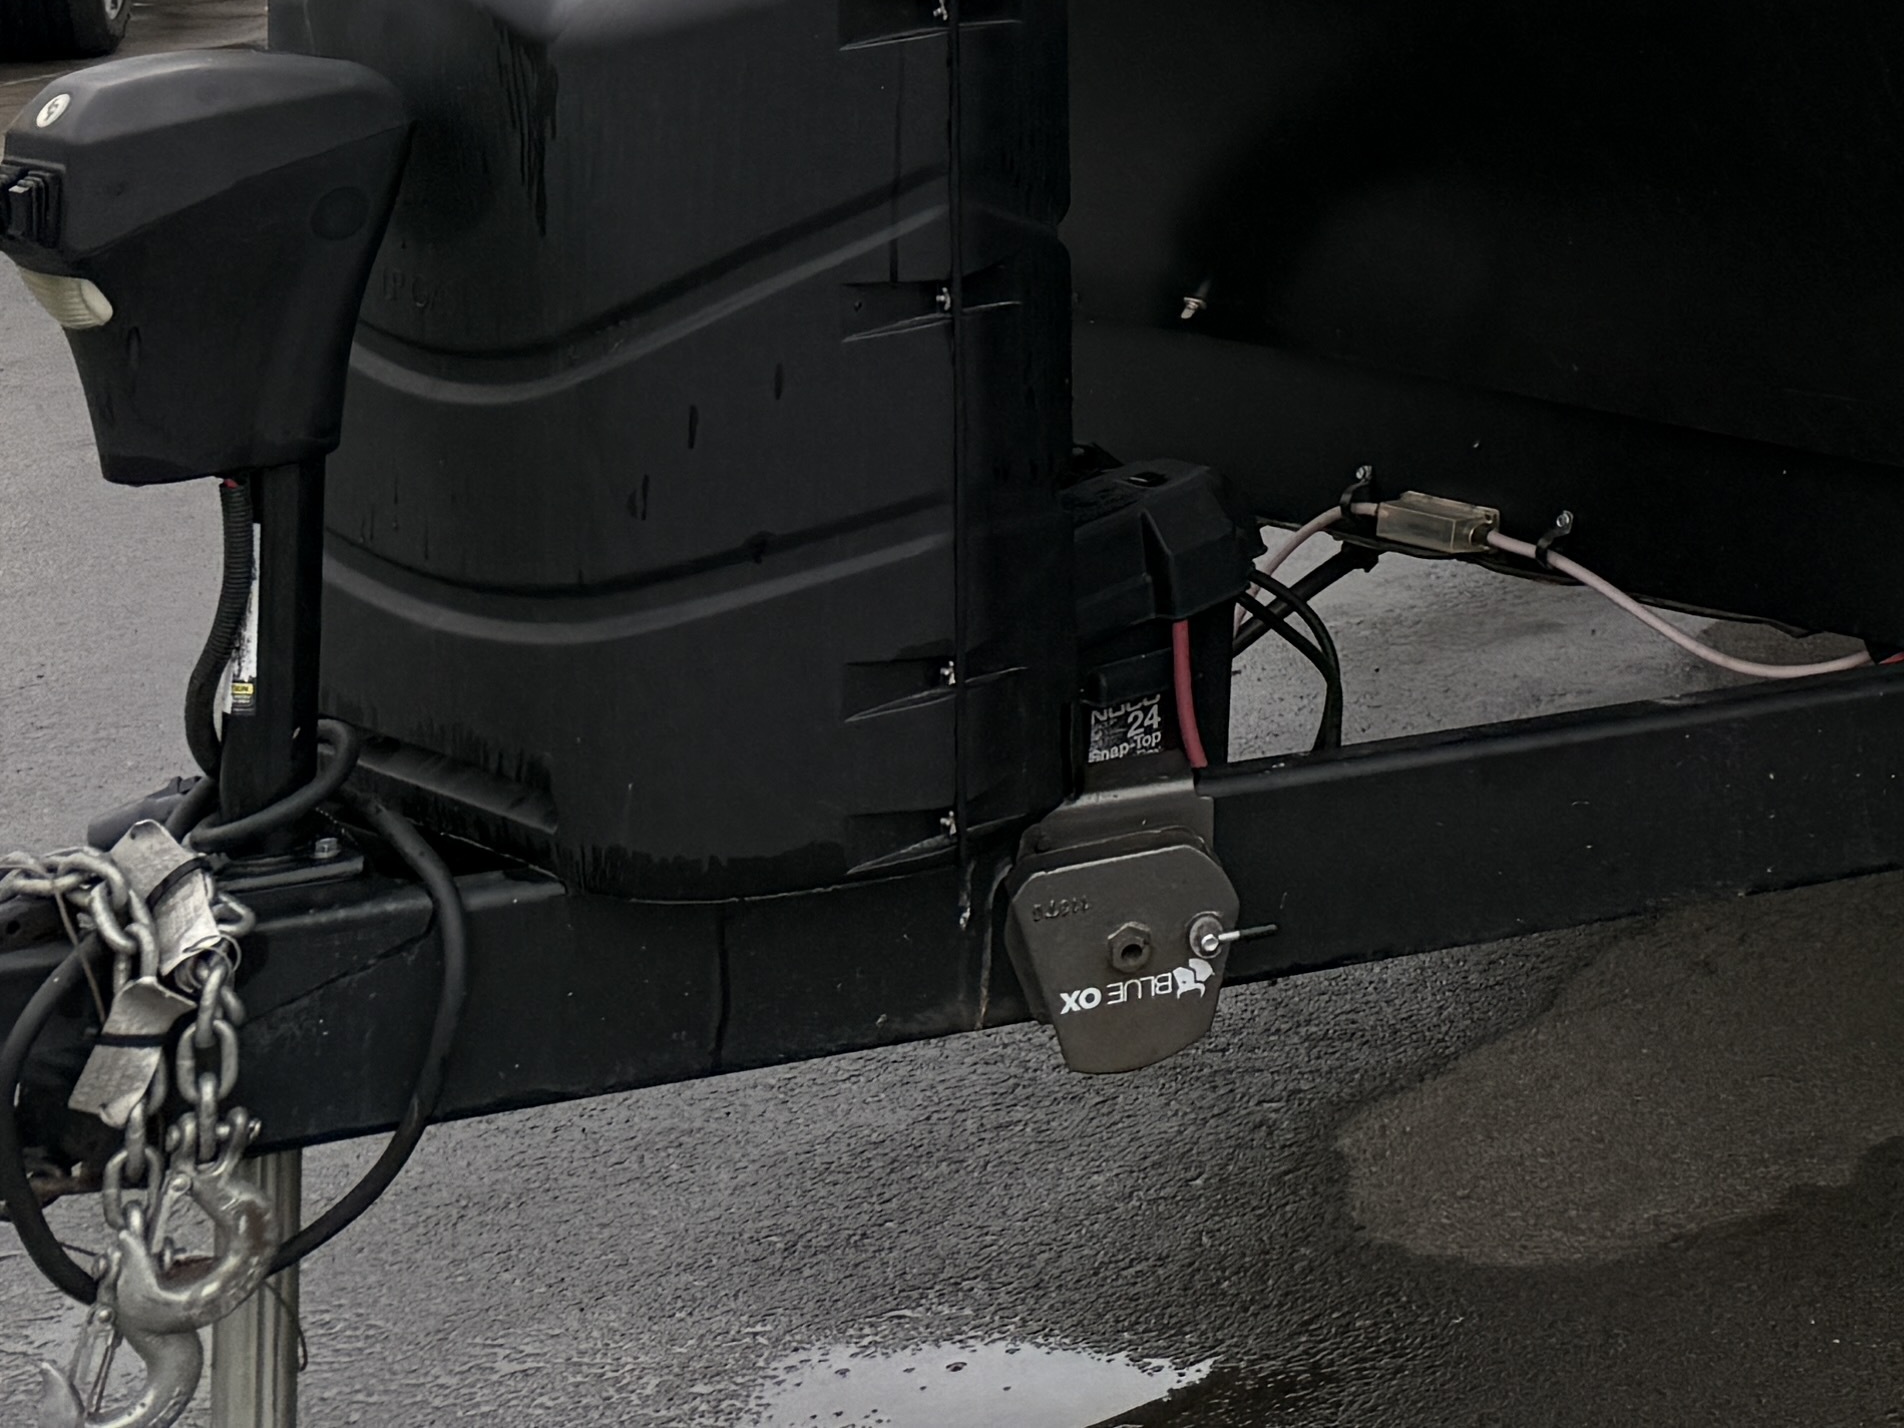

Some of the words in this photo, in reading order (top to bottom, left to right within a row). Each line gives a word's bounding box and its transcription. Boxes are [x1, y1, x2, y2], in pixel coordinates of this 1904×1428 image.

[1127, 704, 1161, 738] 24
[1059, 987, 1102, 1014] OX
[1106, 972, 1173, 1005] BLUE
